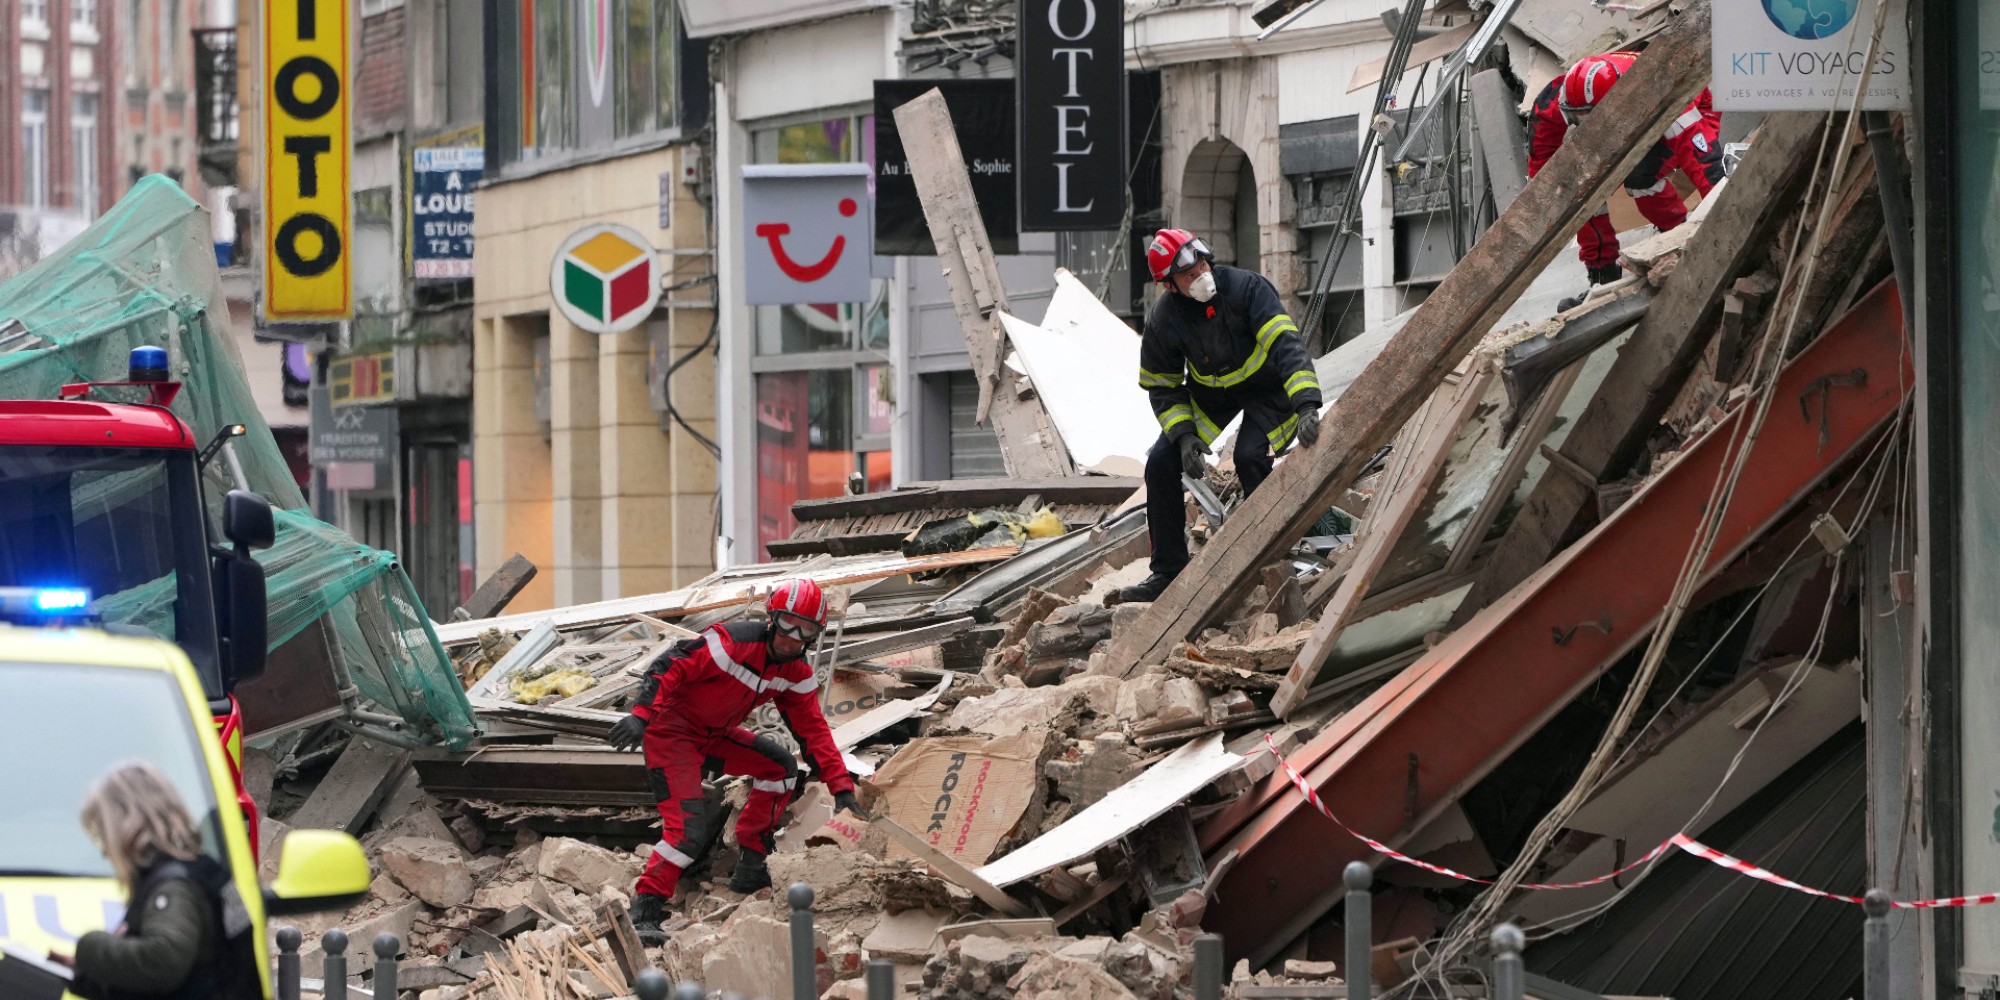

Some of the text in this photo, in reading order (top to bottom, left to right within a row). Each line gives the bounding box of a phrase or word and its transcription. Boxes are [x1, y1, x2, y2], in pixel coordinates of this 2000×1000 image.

[1732, 52, 1772, 75] KIT
[1731, 86, 1898, 97] DES VOYAGES À VORE ESURE
[881, 161, 899, 175] Au
[973, 159, 1012, 176] Sophie
[445, 171, 462, 191] A
[926, 752, 967, 834] ROCK
[952, 760, 992, 854] ROCKWOOL
